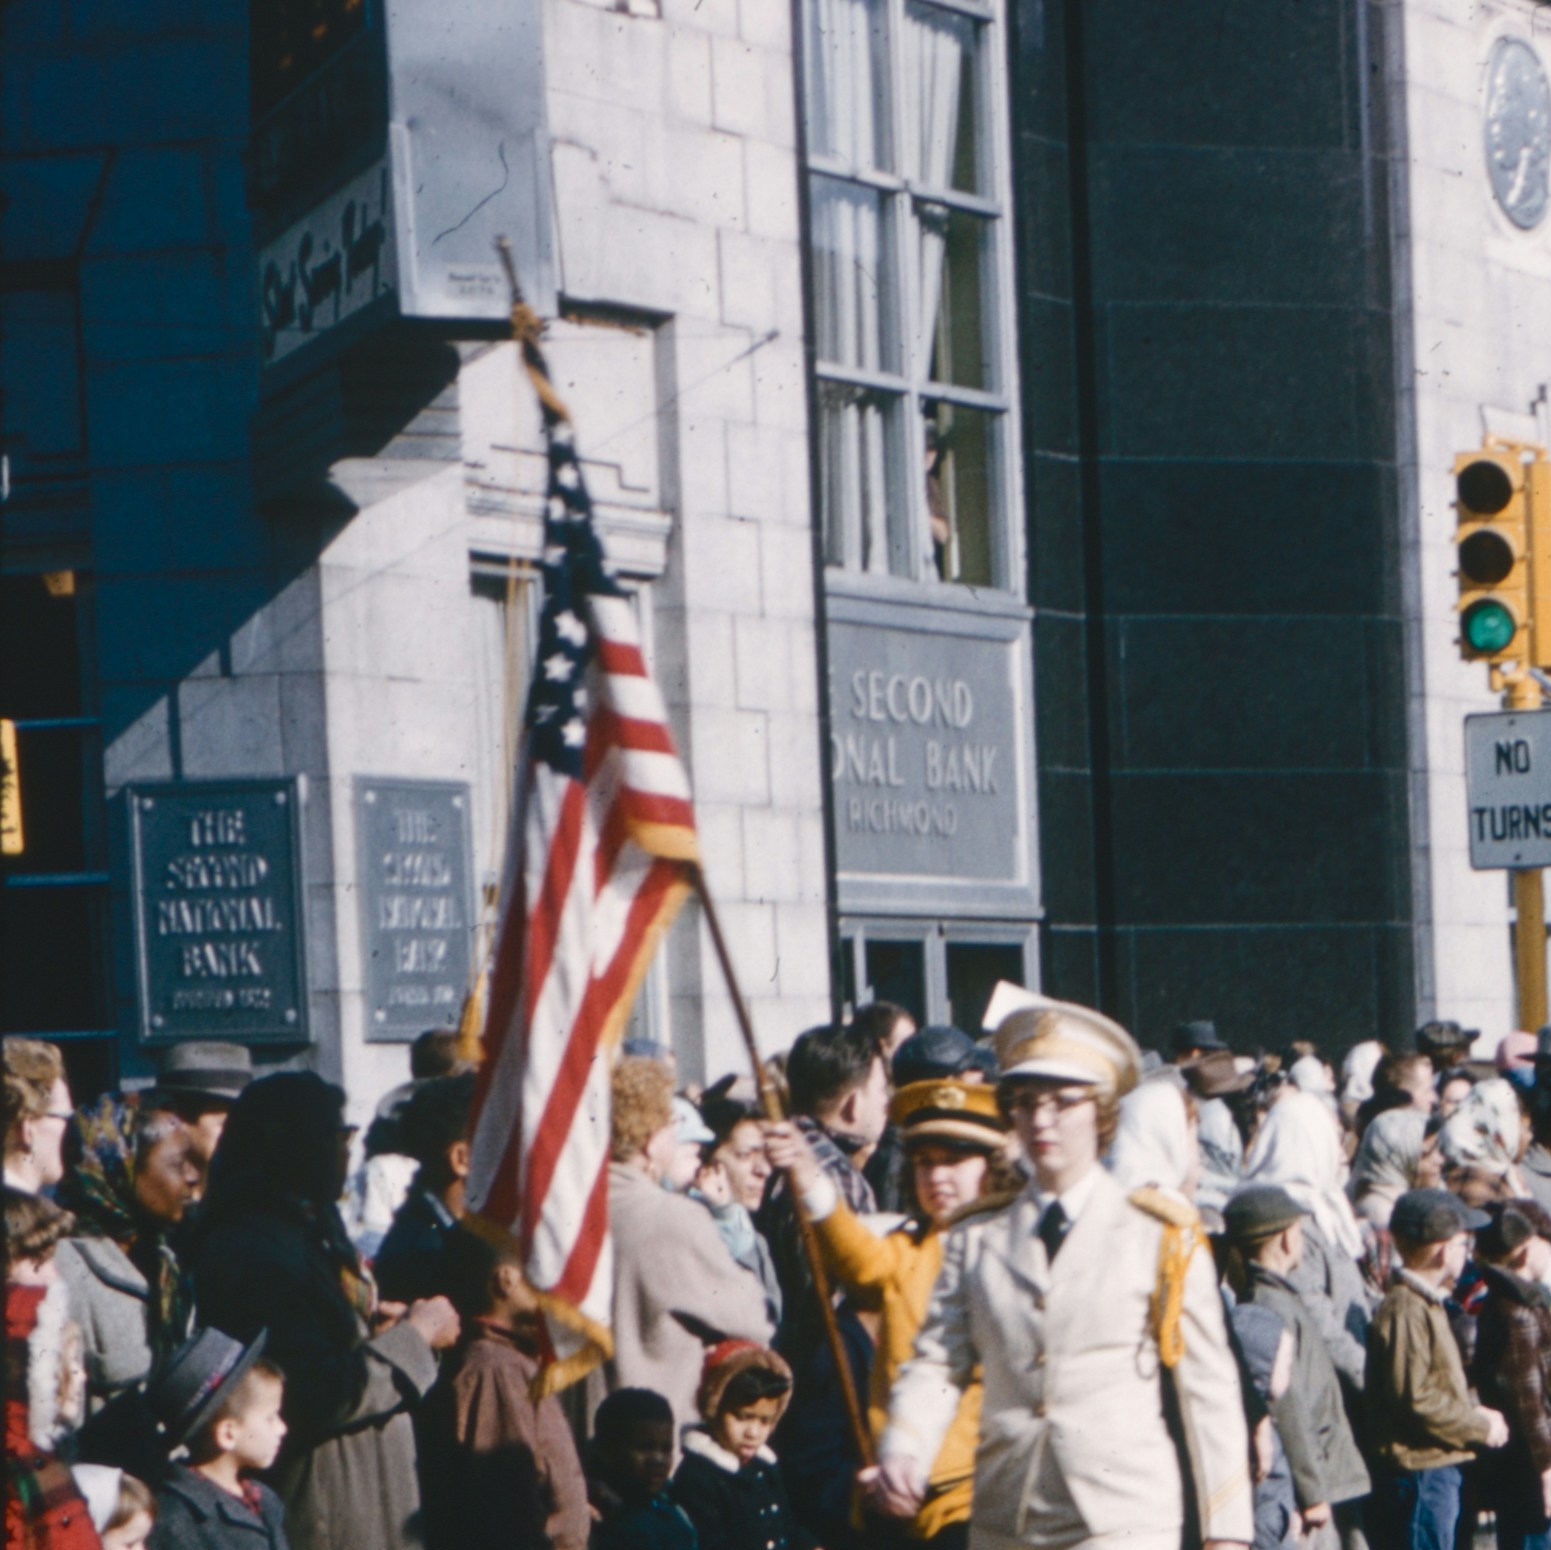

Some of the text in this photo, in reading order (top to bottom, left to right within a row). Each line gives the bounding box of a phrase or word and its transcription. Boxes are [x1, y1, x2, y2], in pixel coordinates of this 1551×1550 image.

[851, 669, 973, 728] SECOND
[925, 740, 998, 796] BANK
[1495, 738, 1531, 775] NO
[189, 809, 247, 846] THE
[847, 797, 958, 837] RICHMOND
[158, 896, 283, 935] NATIONAL
[183, 939, 264, 978] BANK
